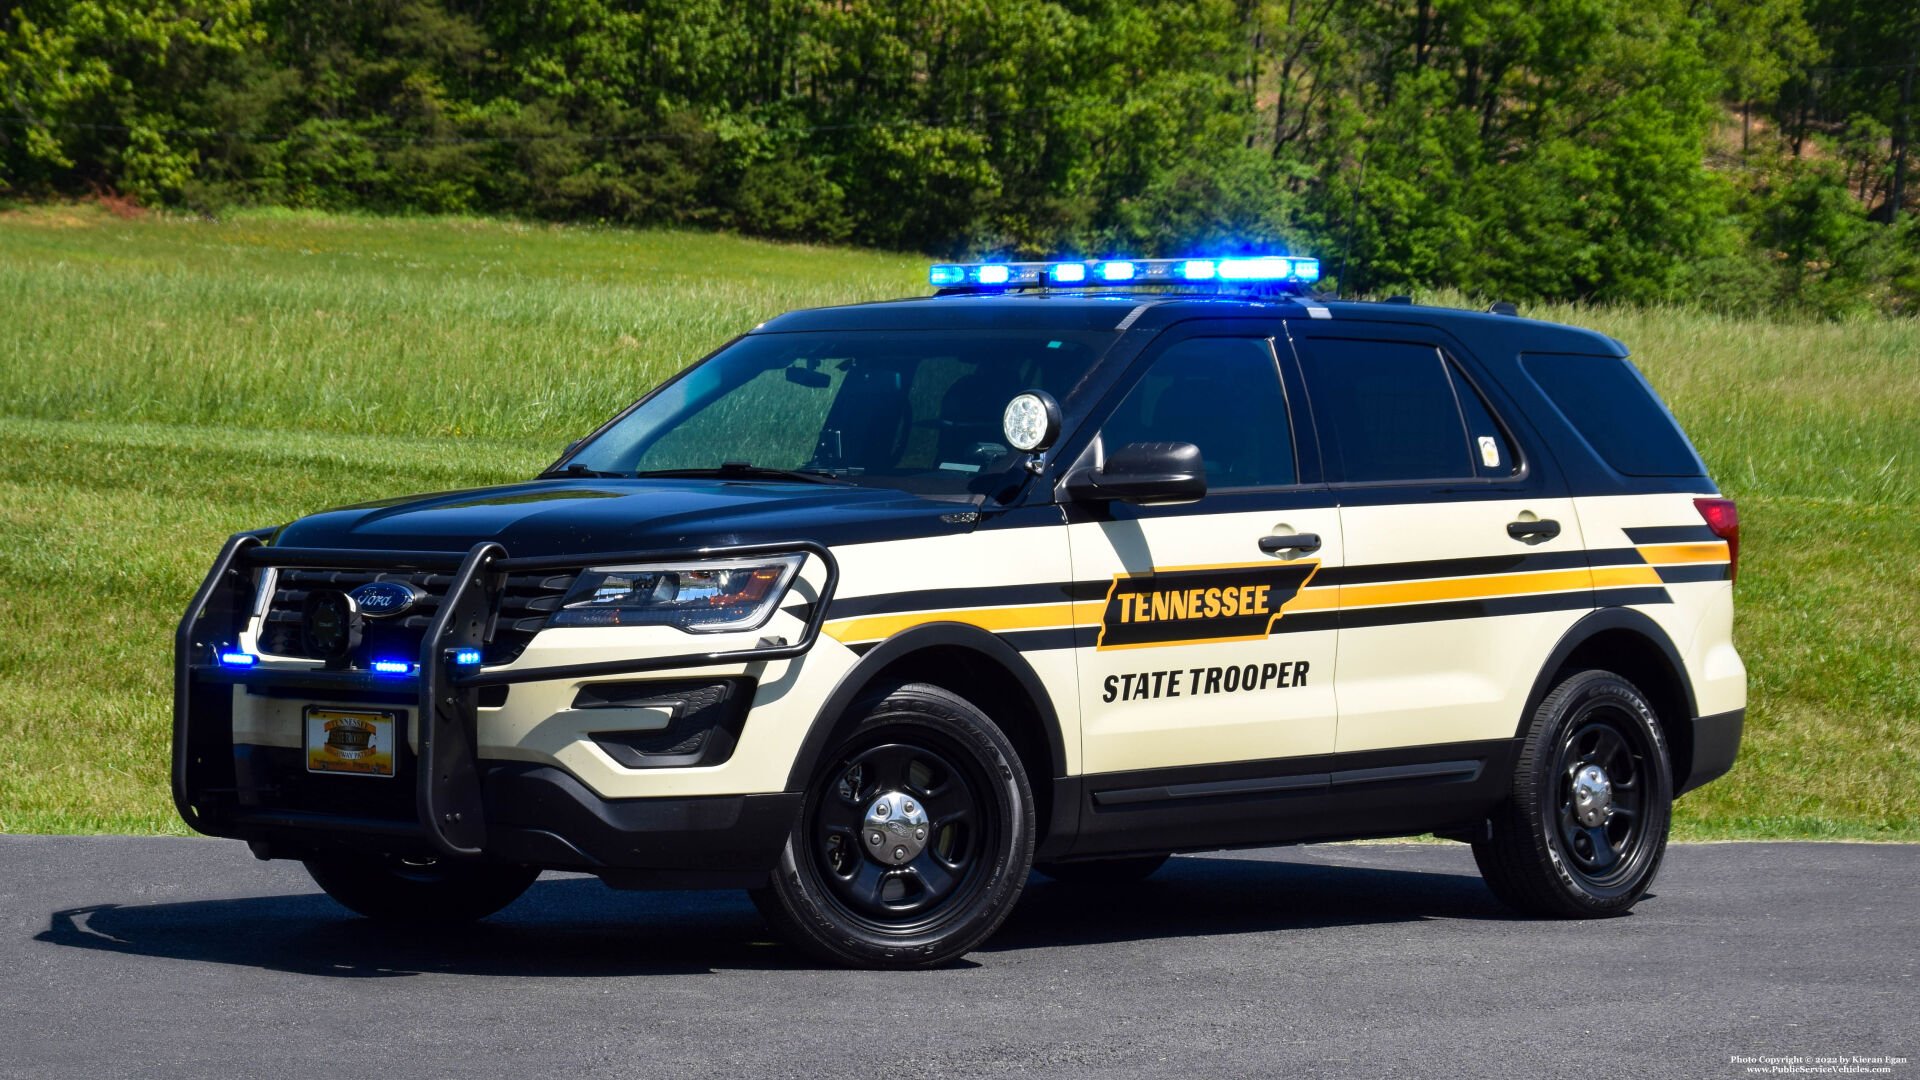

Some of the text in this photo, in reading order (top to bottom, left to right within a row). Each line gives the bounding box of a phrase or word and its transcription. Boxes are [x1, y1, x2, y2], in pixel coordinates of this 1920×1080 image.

[358, 586, 392, 607] Ford
[1117, 584, 1271, 624] TENNESSEE
[1102, 660, 1310, 704] STATE TROOPER
